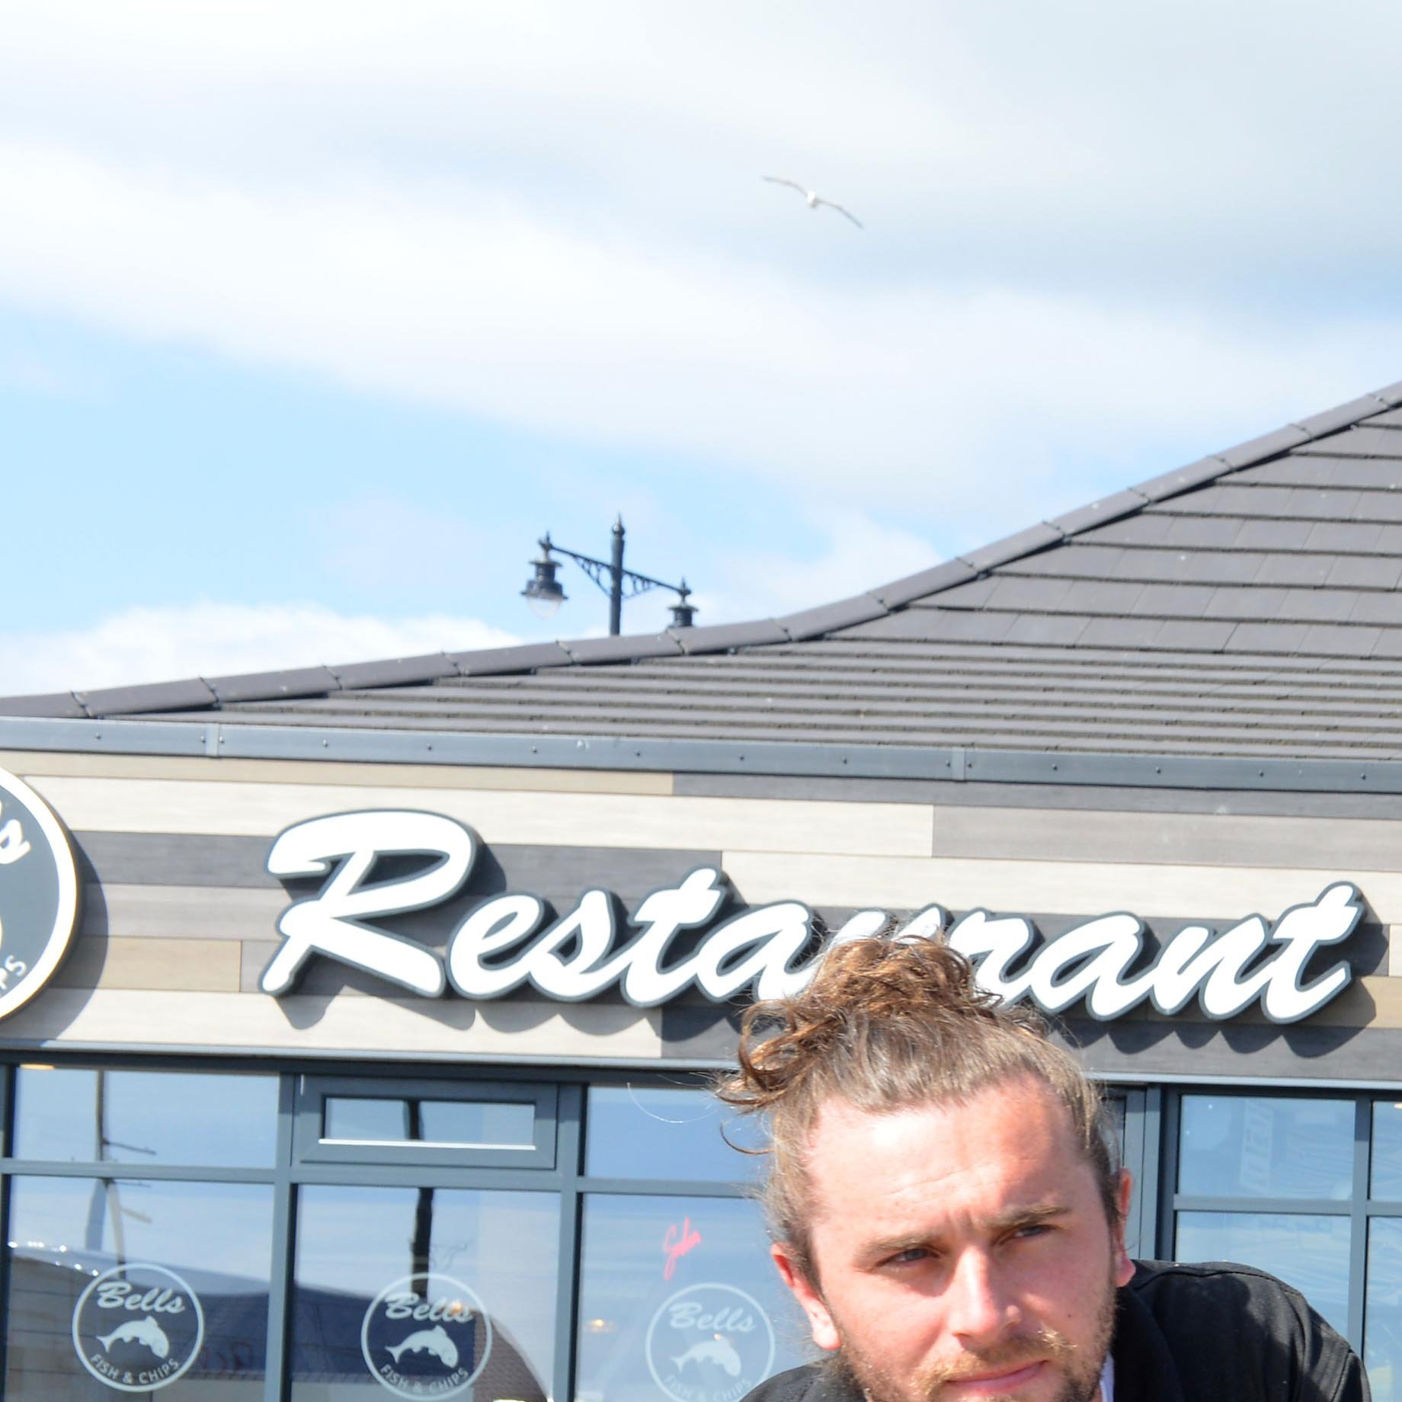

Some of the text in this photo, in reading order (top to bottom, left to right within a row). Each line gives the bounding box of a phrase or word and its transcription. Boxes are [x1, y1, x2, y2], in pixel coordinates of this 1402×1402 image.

[97, 1281, 185, 1313] Bells
[384, 1292, 474, 1323] Bells
[669, 1302, 755, 1333] Bells
[90, 1354, 179, 1384] FISH & CHIPS
[380, 1364, 408, 1389] FISH
[429, 1368, 469, 1393] CHIPS
